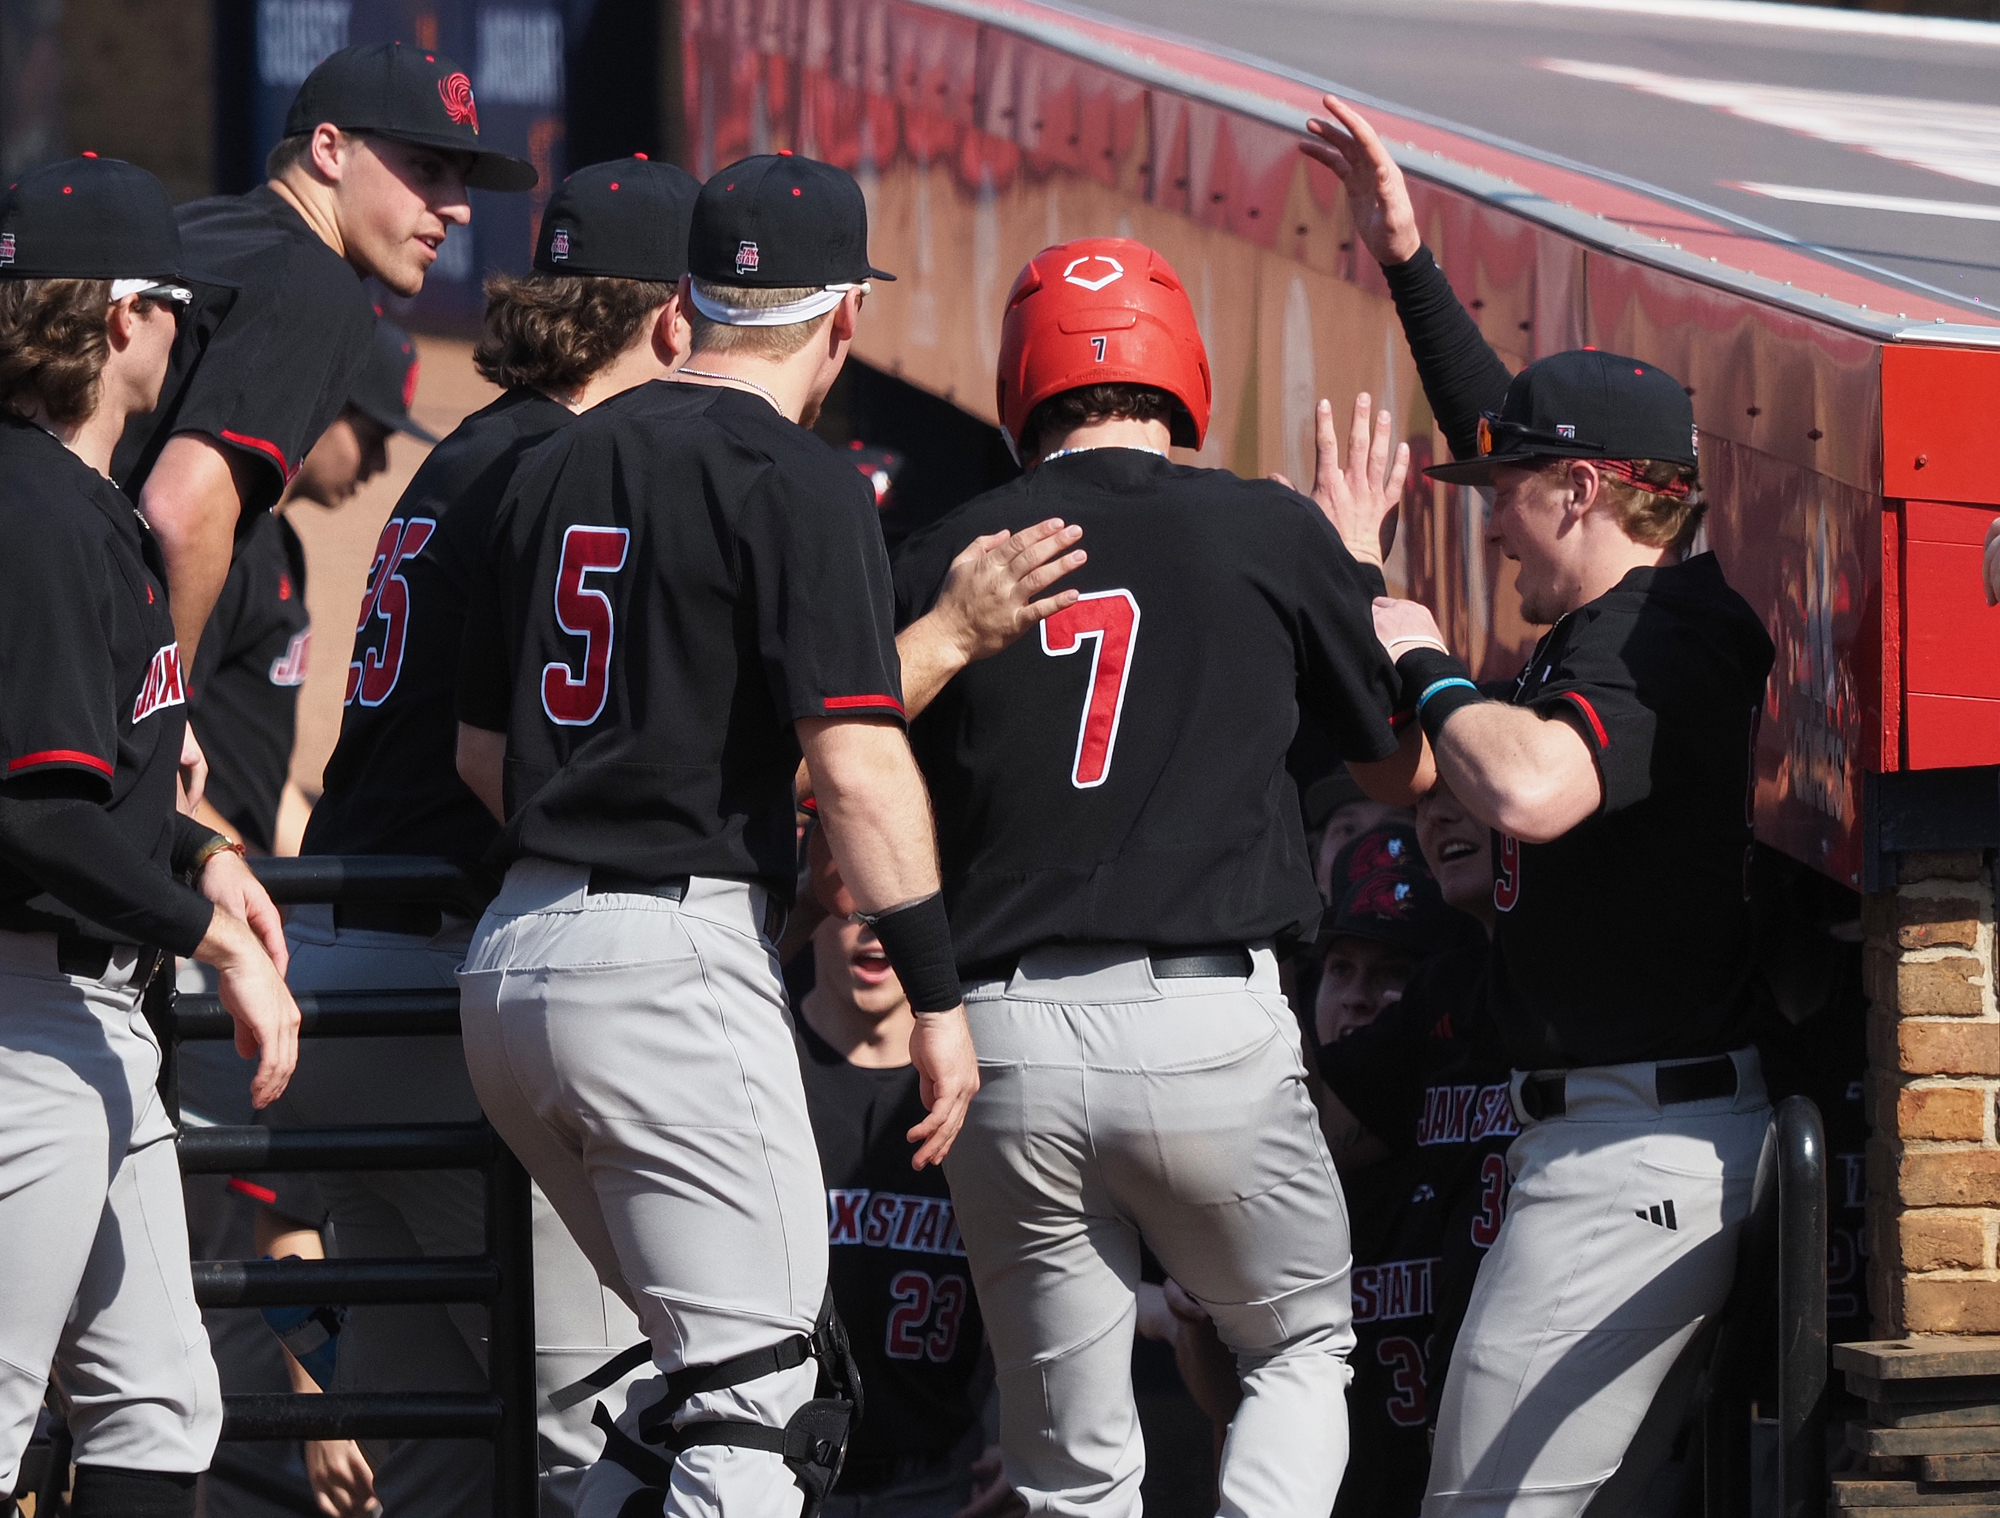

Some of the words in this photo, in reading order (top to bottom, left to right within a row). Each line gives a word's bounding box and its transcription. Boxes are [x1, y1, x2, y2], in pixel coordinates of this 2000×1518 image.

[1090, 336, 1107, 363] 7
[541, 524, 630, 726] 5
[132, 640, 185, 724] JAX
[1039, 588, 1141, 789] 7
[1417, 1085, 1477, 1147] JAX
[1471, 1153, 1516, 1250] 3
[884, 1269, 967, 1363] 23
[1377, 1334, 1434, 1427] 3
